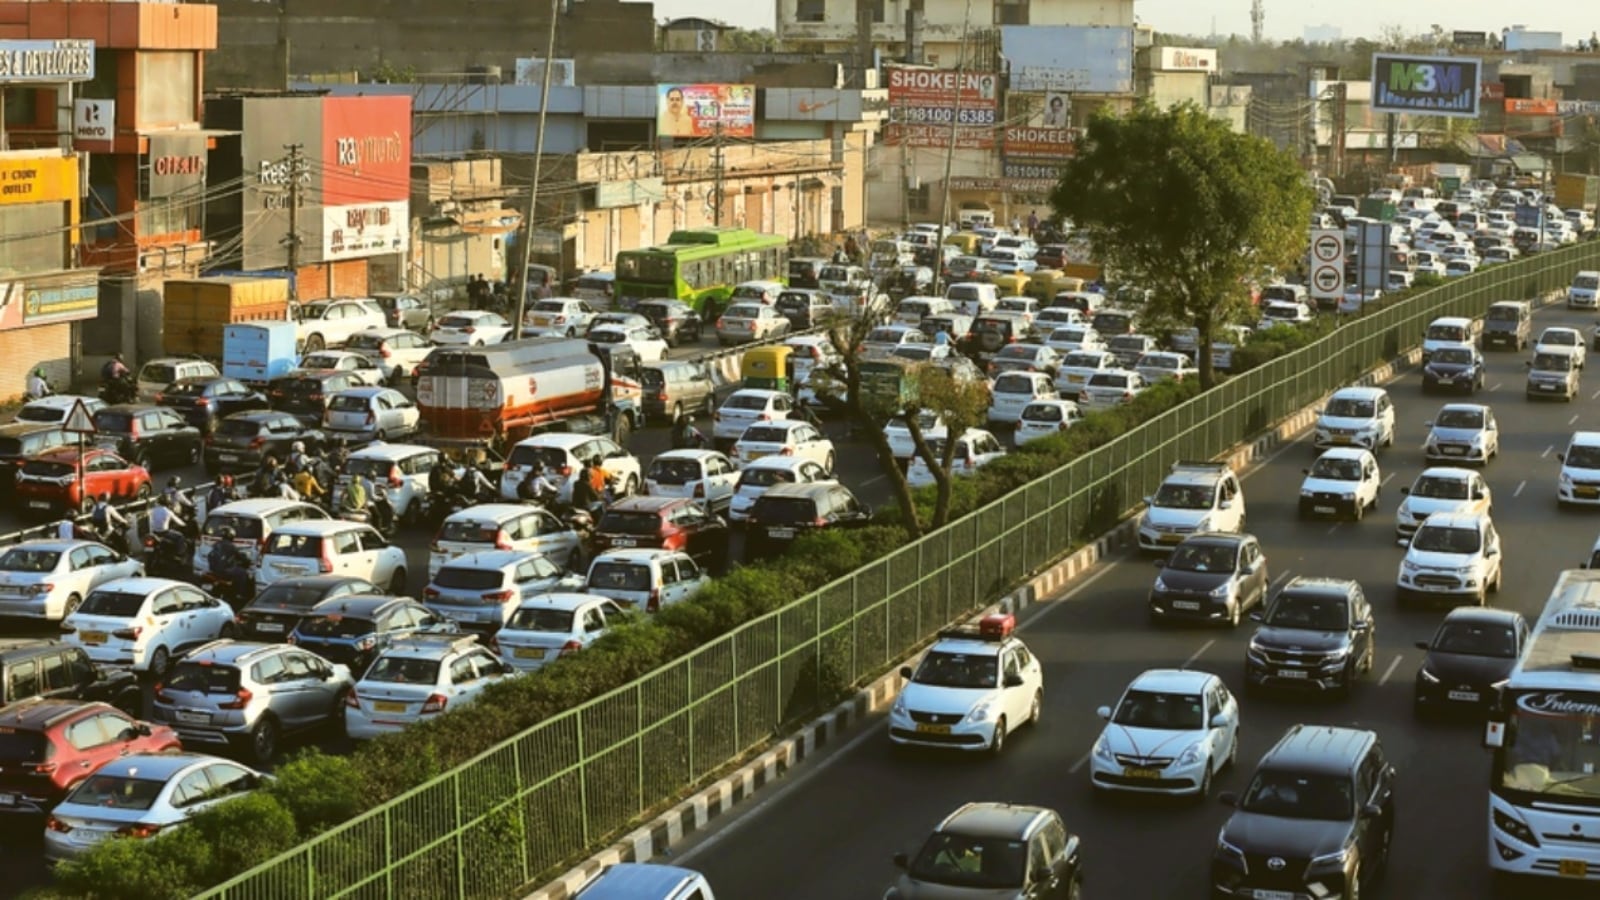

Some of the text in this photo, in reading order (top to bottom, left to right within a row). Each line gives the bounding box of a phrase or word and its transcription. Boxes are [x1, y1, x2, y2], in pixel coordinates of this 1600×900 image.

[25, 50, 90, 75] DEVELOPERS
[891, 71, 979, 90] SHOKEEN
[1390, 62, 1462, 93] M3M
[78, 126, 106, 136] Hero
[1007, 129, 1077, 144] SHOKEEN
